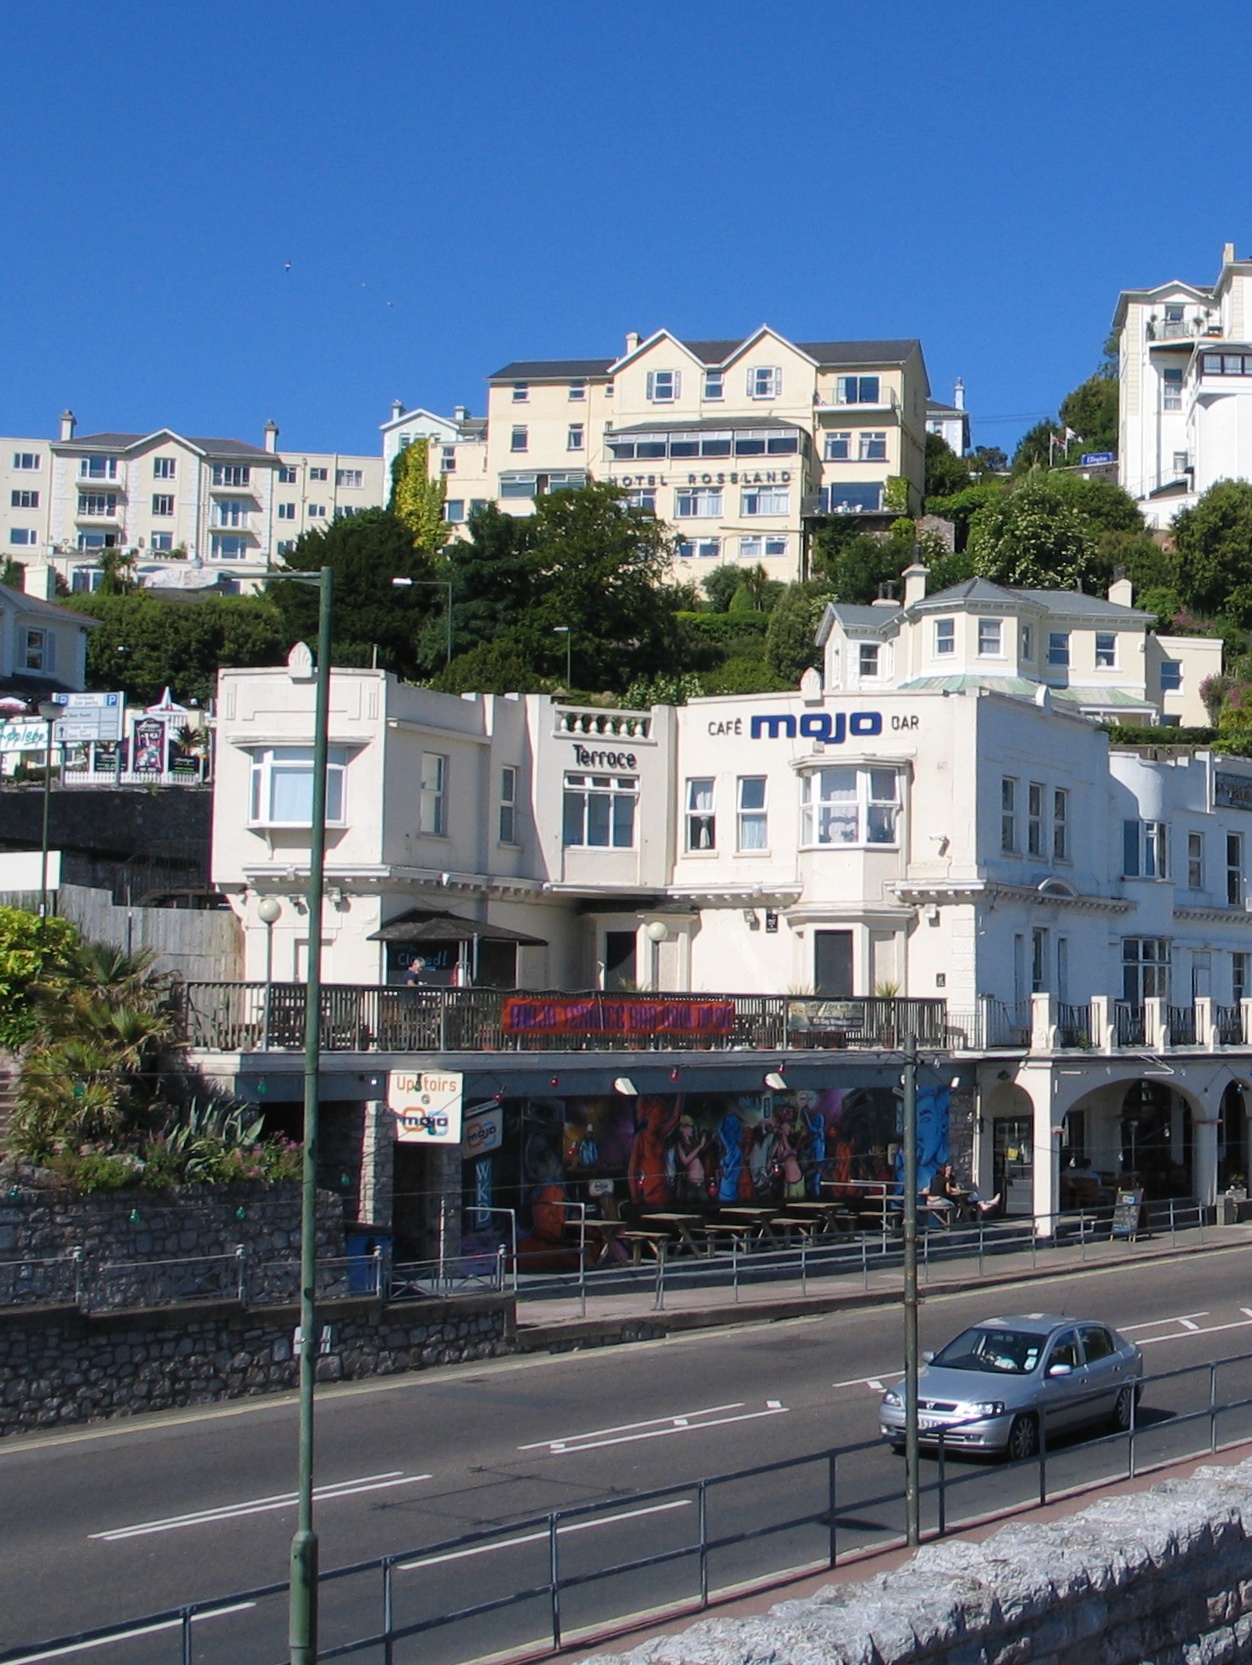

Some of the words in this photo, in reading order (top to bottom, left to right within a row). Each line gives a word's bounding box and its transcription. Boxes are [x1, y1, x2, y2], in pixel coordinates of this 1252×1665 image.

[608, 475, 668, 487] HOTEL
[688, 471, 792, 485] ROSELAND
[707, 718, 742, 735] CAFÉ
[750, 712, 882, 744] mojo
[891, 715, 920, 731] BAR
[572, 744, 638, 769] Terrace
[396, 1075, 457, 1093] Uptairs
[401, 1115, 448, 1131] mojo
[466, 1125, 497, 1142] mojo
[475, 1163, 491, 1222] WKD
